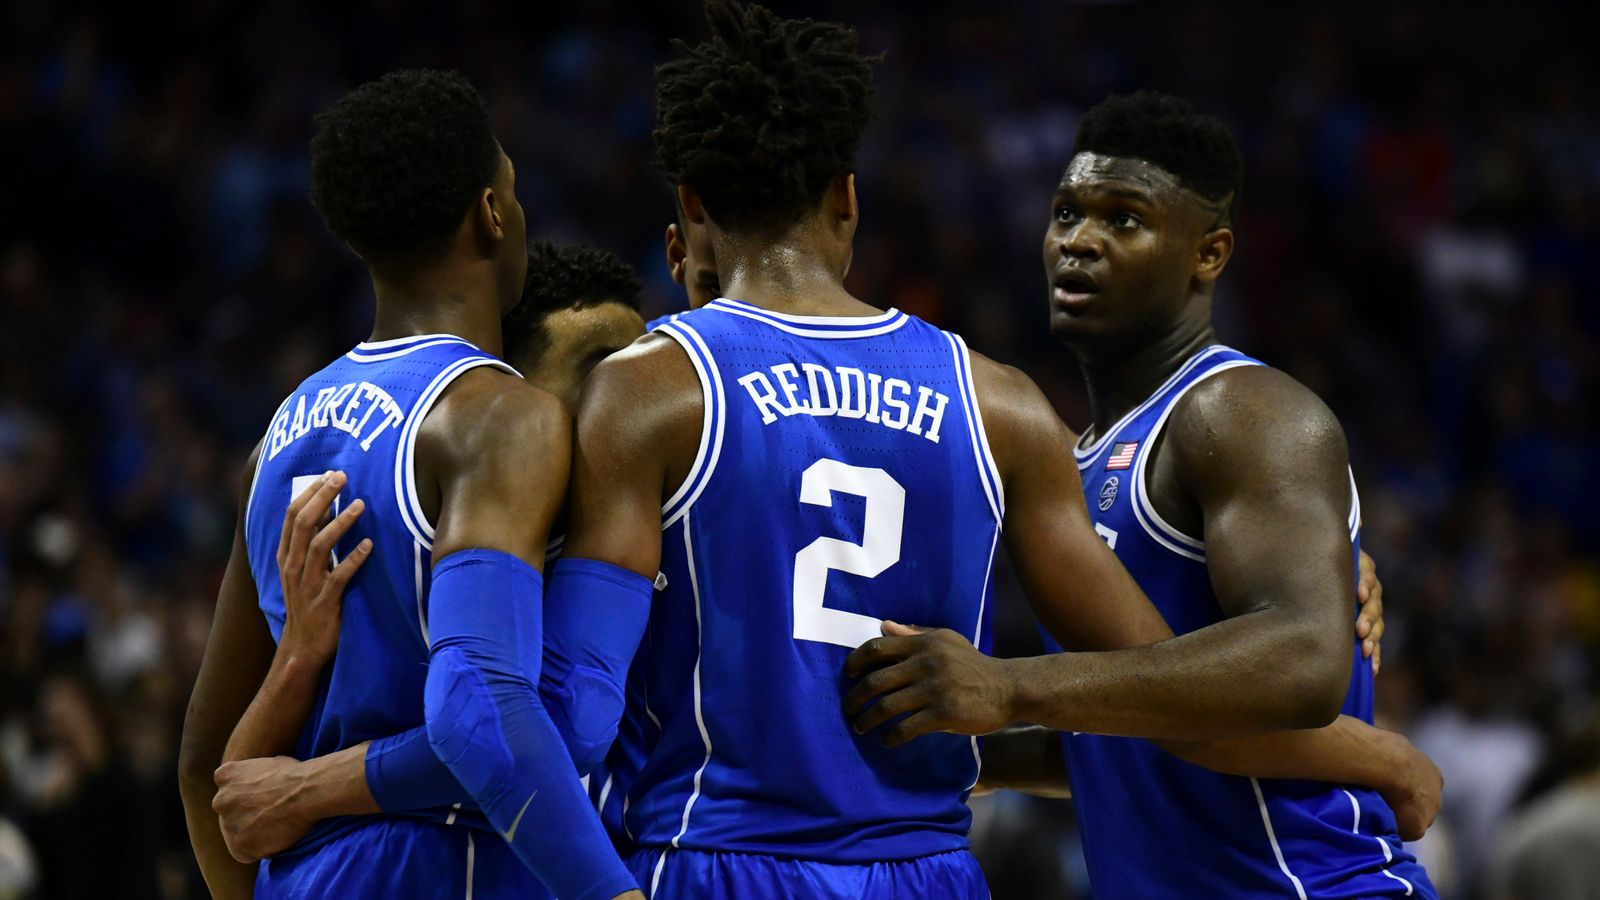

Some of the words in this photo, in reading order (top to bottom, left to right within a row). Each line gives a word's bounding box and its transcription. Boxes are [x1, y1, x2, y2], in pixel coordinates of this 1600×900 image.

[268, 381, 405, 462] BARRETT
[737, 362, 949, 444] REDDISH
[792, 457, 906, 649] 2
